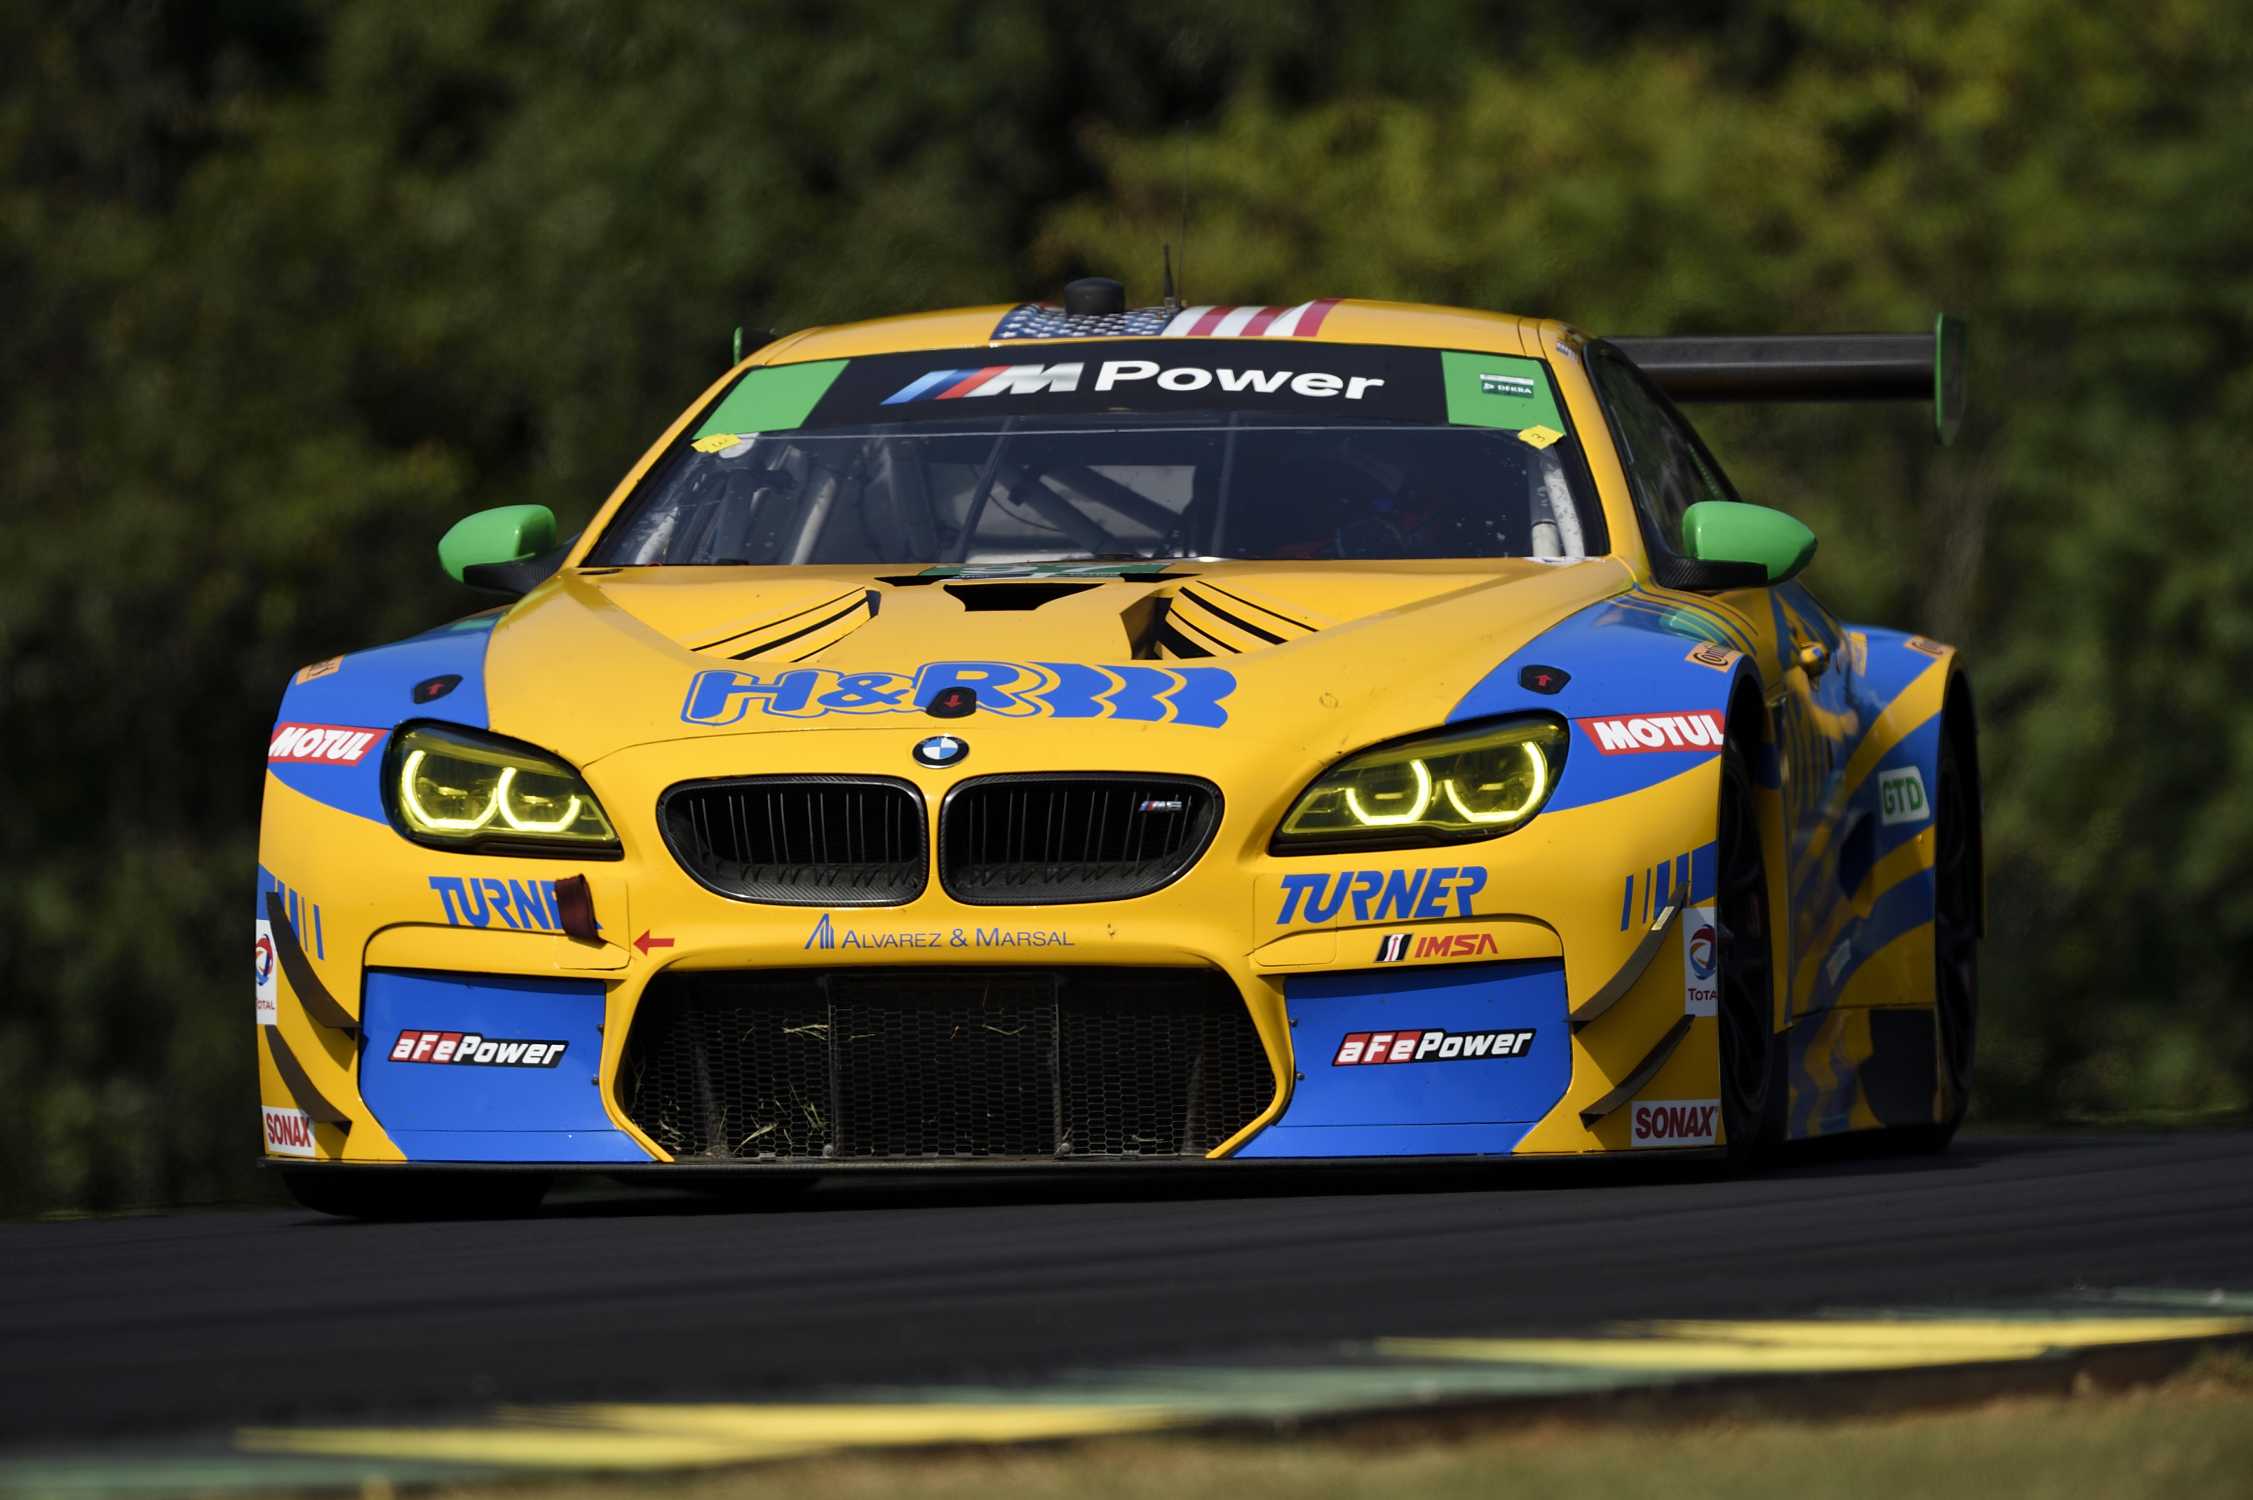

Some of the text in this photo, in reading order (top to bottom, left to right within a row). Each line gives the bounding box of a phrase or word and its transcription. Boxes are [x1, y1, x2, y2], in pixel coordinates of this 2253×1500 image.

[1095, 360, 1384, 399] Power
[681, 661, 1045, 726] H&R
[269, 726, 375, 761] MOTUL
[1592, 714, 1725, 750] MOTUL
[1883, 776, 1923, 815] GTD
[428, 876, 604, 930] TURN
[1276, 866, 1488, 925] TURNER
[841, 927, 1075, 949] ALVAREZ & MARSAL
[1414, 933, 1499, 959] IMSA
[1688, 988, 1718, 1001] TOTA
[267, 1114, 312, 1148] SONAX
[1635, 1106, 1714, 1139] SONAX
